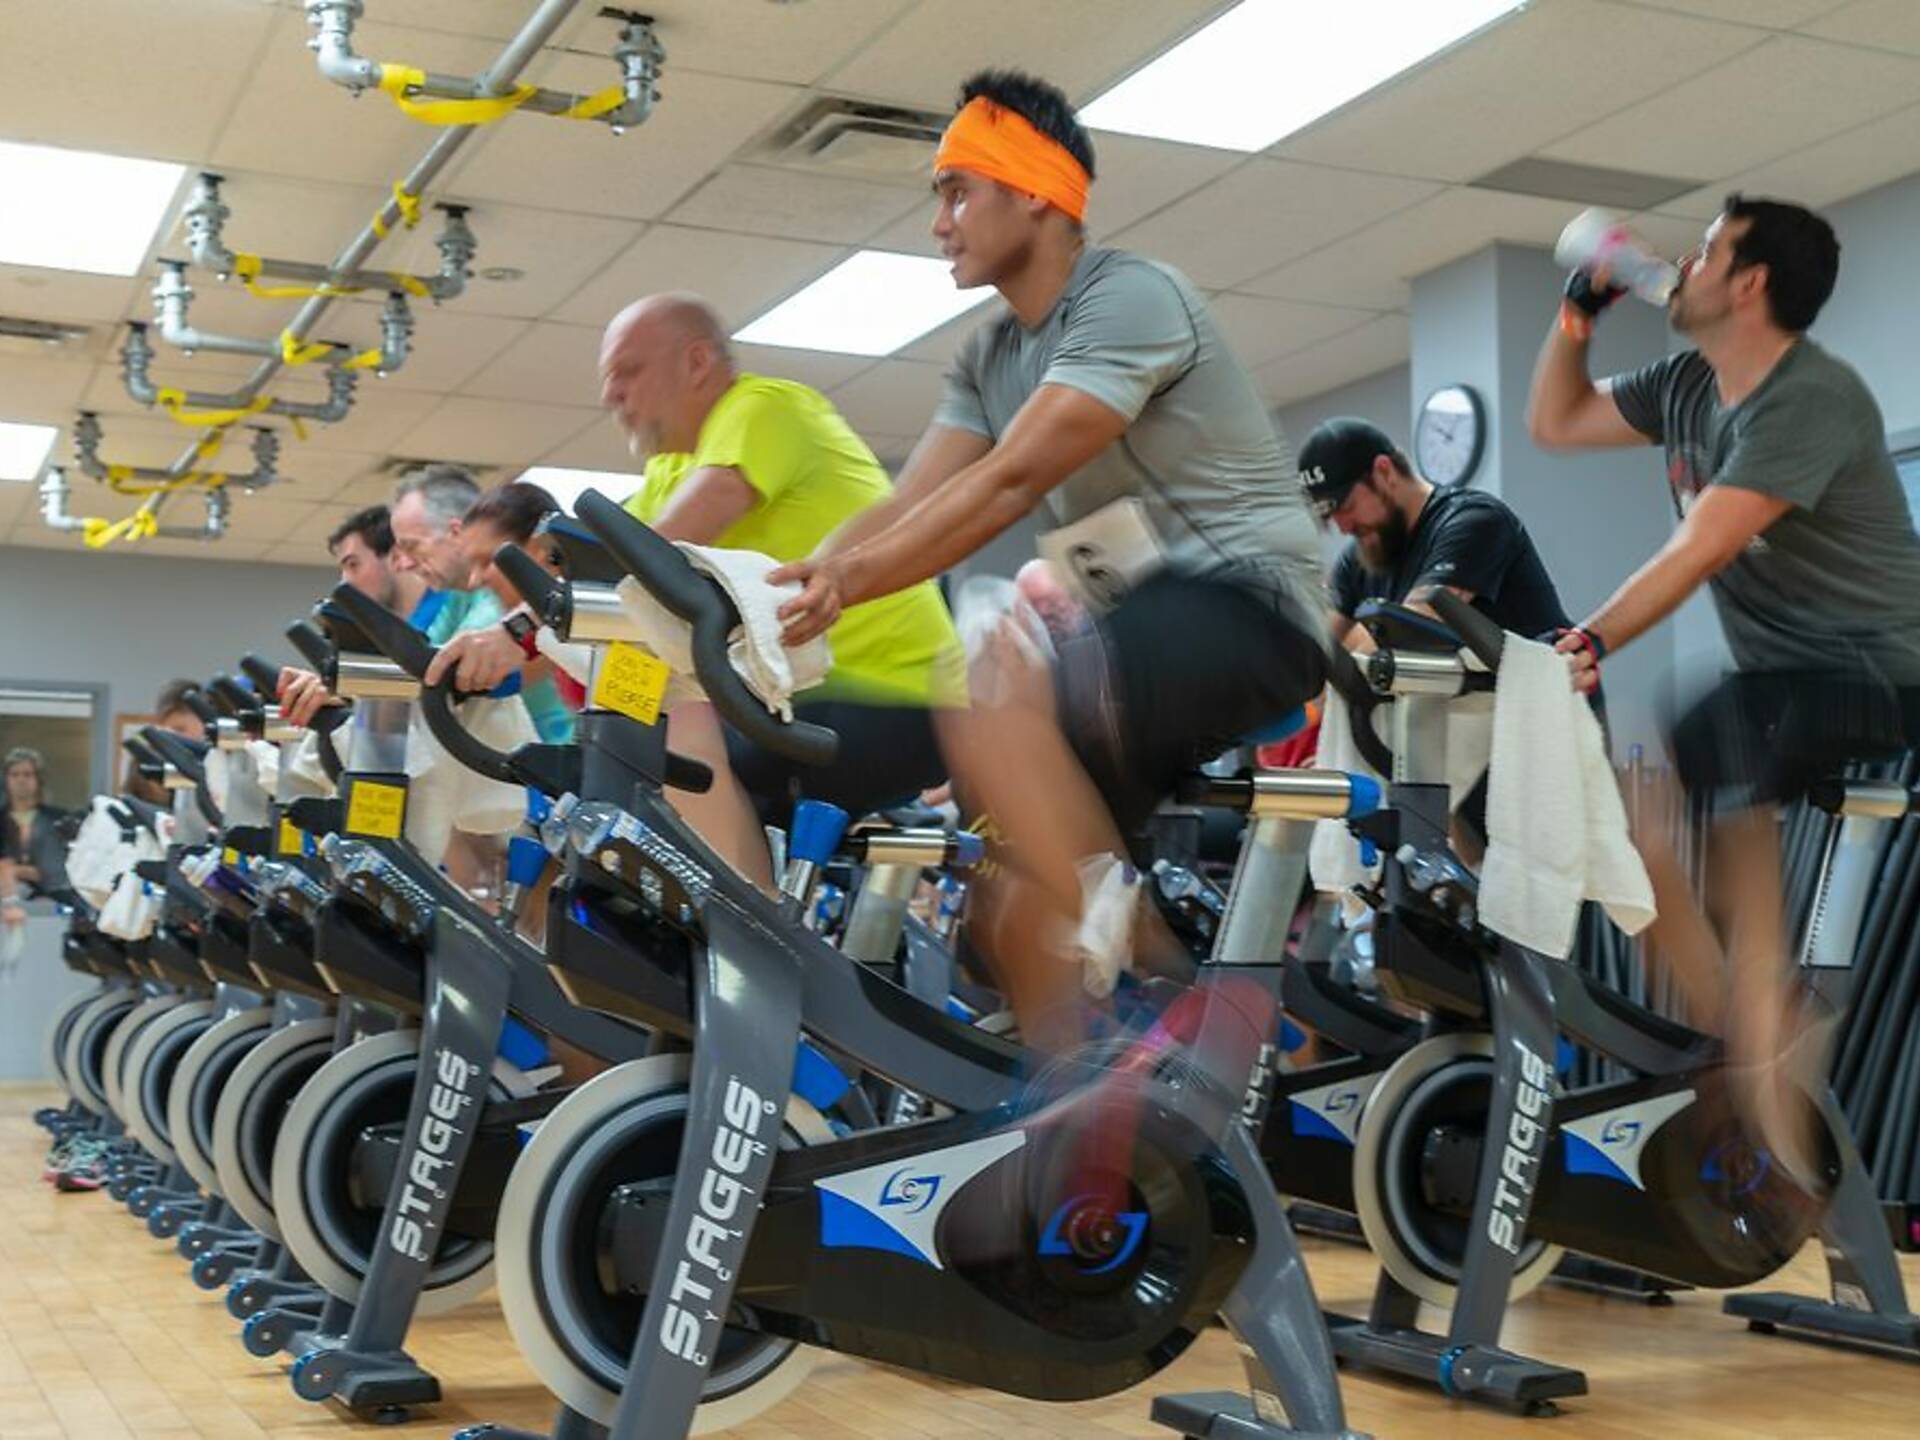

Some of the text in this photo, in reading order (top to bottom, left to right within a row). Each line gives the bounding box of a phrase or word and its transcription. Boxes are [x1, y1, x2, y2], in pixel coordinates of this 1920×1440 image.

[390, 1049, 469, 1258] STAGES
[659, 1079, 763, 1362] STAGES
[1487, 1052, 1547, 1252] STAGES
